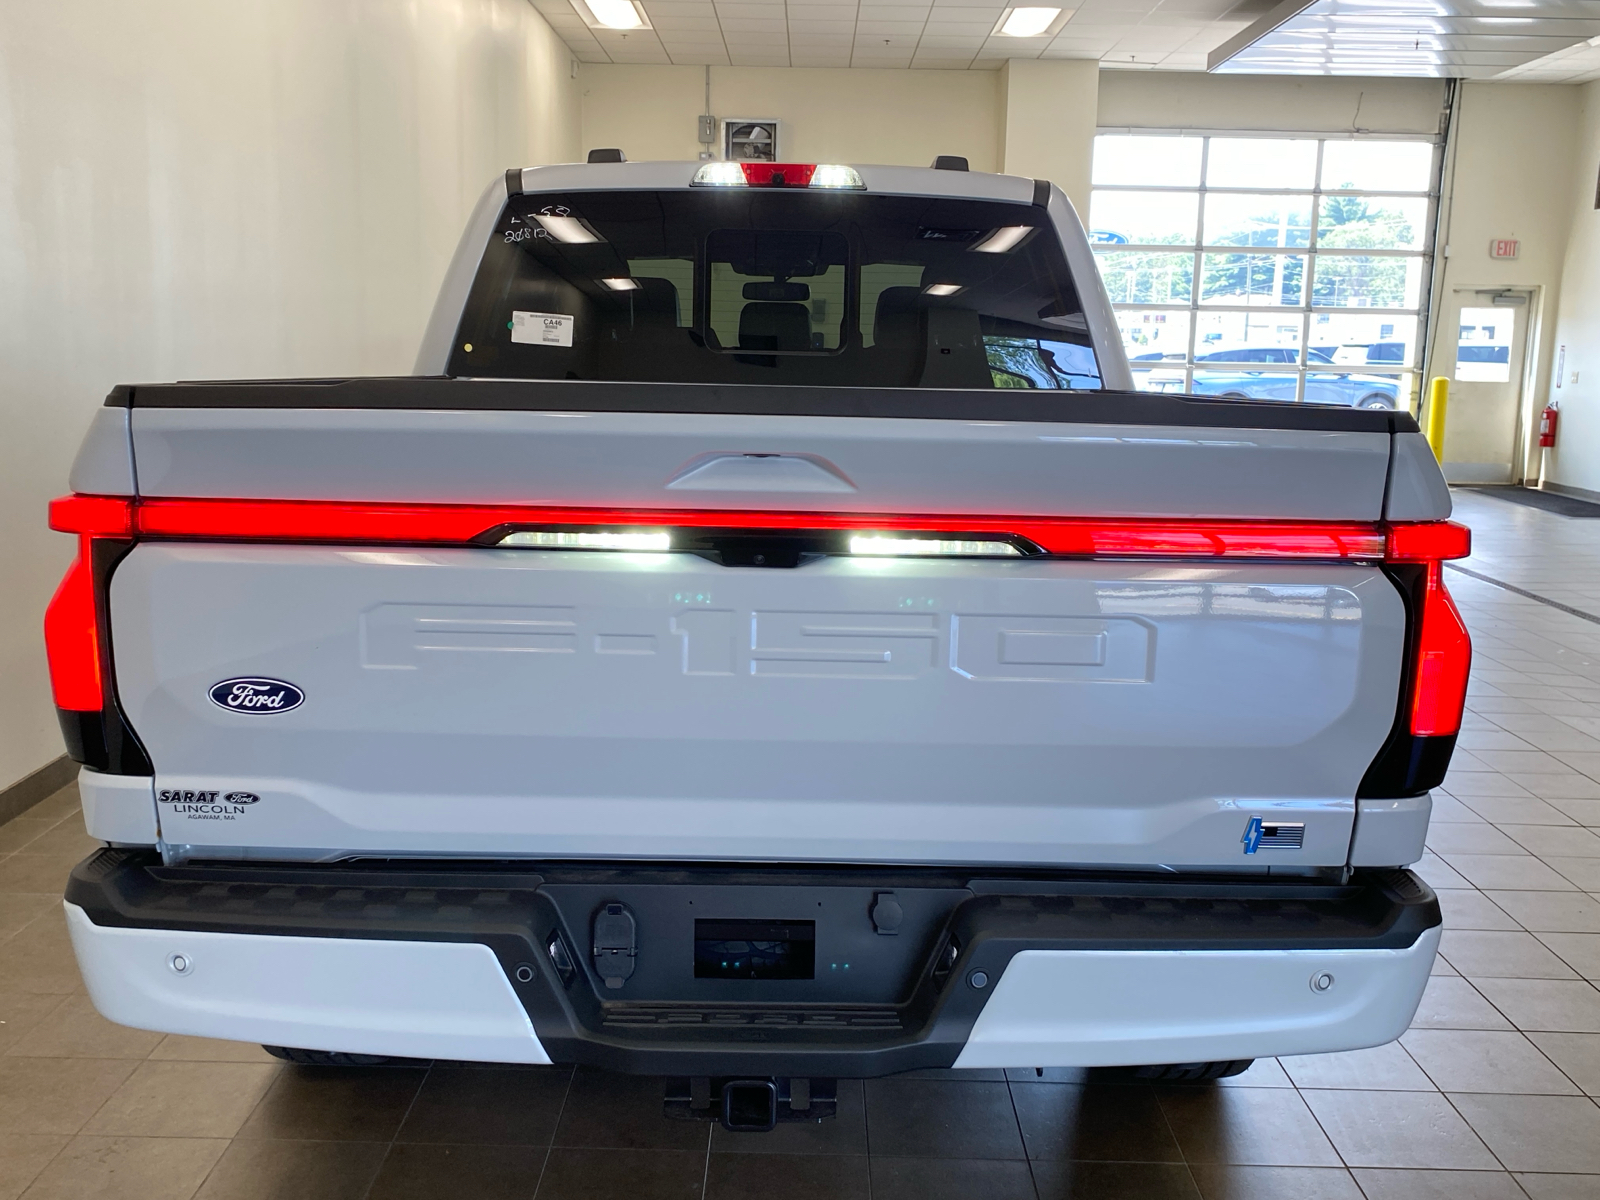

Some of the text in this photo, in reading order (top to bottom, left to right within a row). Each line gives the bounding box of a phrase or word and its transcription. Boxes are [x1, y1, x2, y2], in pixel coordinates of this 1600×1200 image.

[1496, 240, 1518, 257] EXIT
[543, 318, 563, 327] CA46
[358, 601, 1158, 685] F-150
[227, 683, 286, 708] Ford
[159, 789, 254, 804] SARAT Ford
[174, 804, 245, 814] LINCOLN
